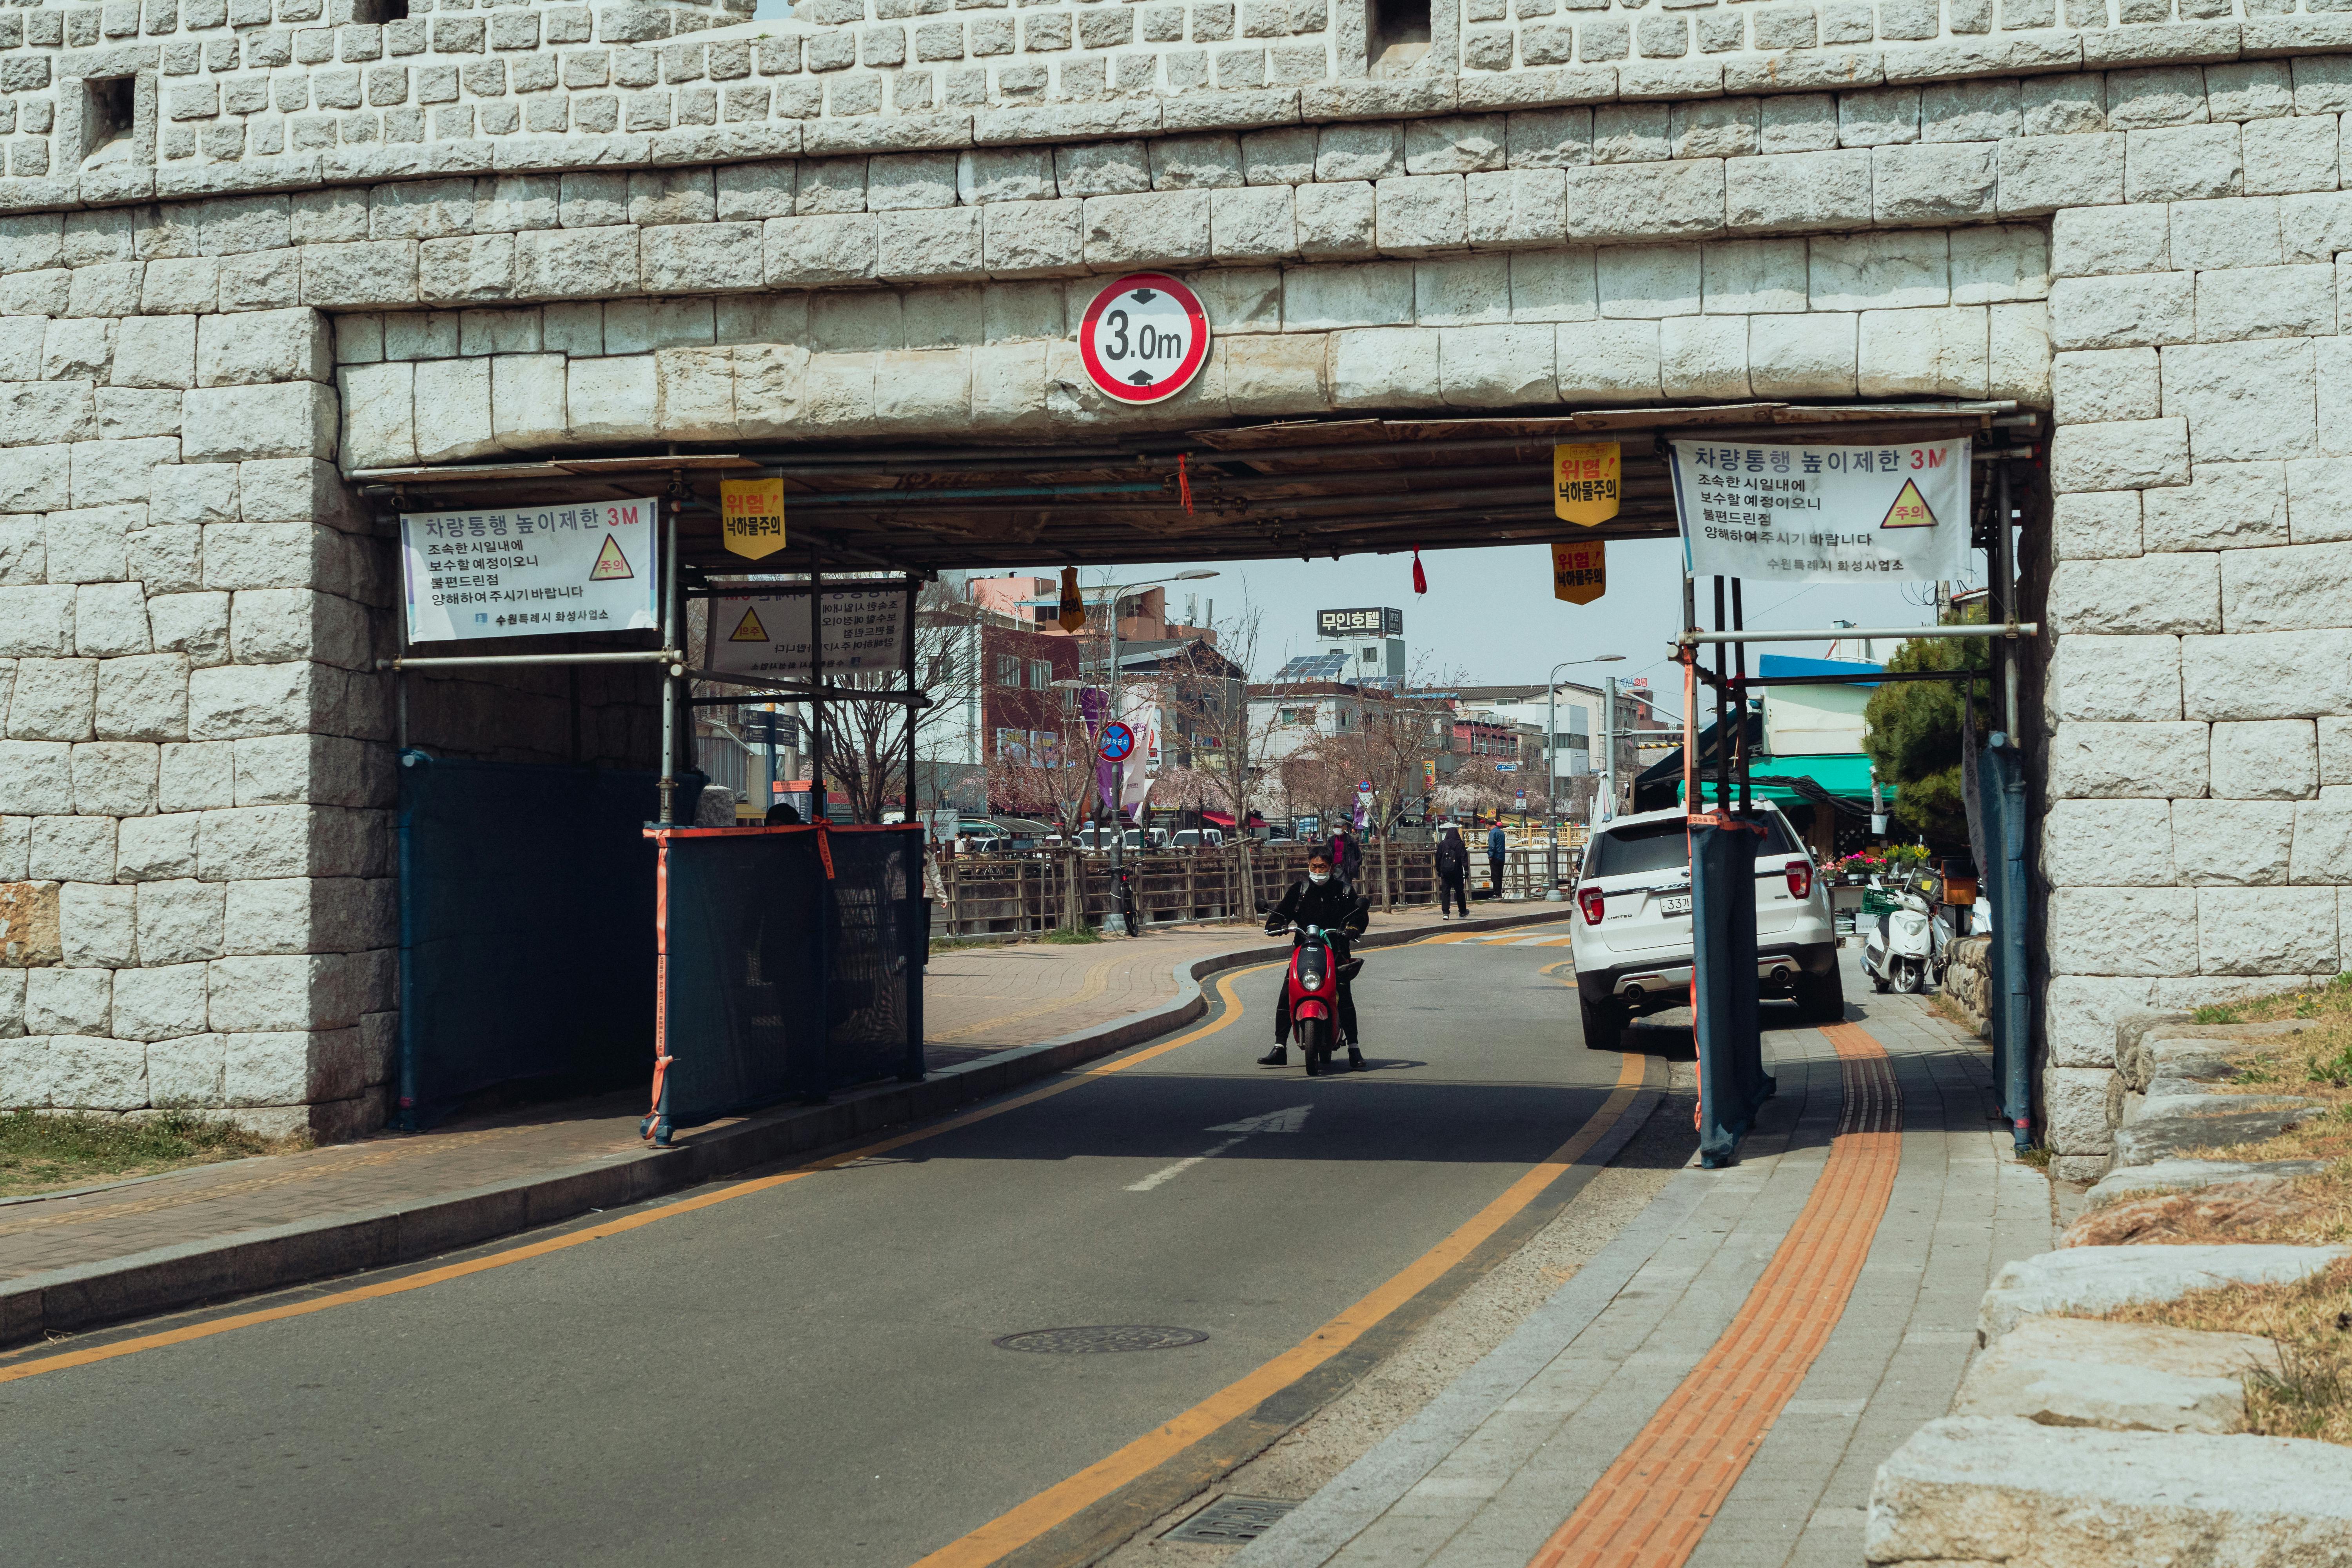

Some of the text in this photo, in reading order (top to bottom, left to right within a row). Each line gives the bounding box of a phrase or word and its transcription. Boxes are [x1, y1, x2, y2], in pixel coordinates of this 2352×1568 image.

[1105, 310, 1181, 360] 3.0m
[1561, 457, 1615, 480] 위험!
[1695, 447, 1947, 474] 차량통행 높이제한 3M
[1559, 479, 1616, 503] 낙하물주의
[1698, 474, 1806, 493] 조속한 시일내에
[726, 494, 778, 514] 위험!
[1701, 492, 1821, 510] 보수할 예정이오니
[426, 506, 639, 538] 차량통행 높이제한 3M
[1703, 508, 1771, 526] 불편드린점
[1895, 506, 1924, 520] 주의
[726, 516, 780, 536] 낙하물주의
[1705, 526, 1872, 546] 양해하여 주시기 바랍니다
[428, 539, 524, 555] 조속한 시일내에
[429, 555, 538, 572] 보수할 예정이오니
[601, 559, 624, 573] 주의
[1557, 551, 1601, 570] 위험!
[1767, 558, 1904, 572] 수원특례시 화성사업소
[431, 574, 499, 589] 불편드린점
[1557, 568, 1602, 588] 낙하물주의
[432, 586, 584, 606] 양해하여 주시기 바랍니다
[495, 610, 609, 626] 수원특례시 화성사업소
[1322, 611, 1379, 630] 무인호텔
